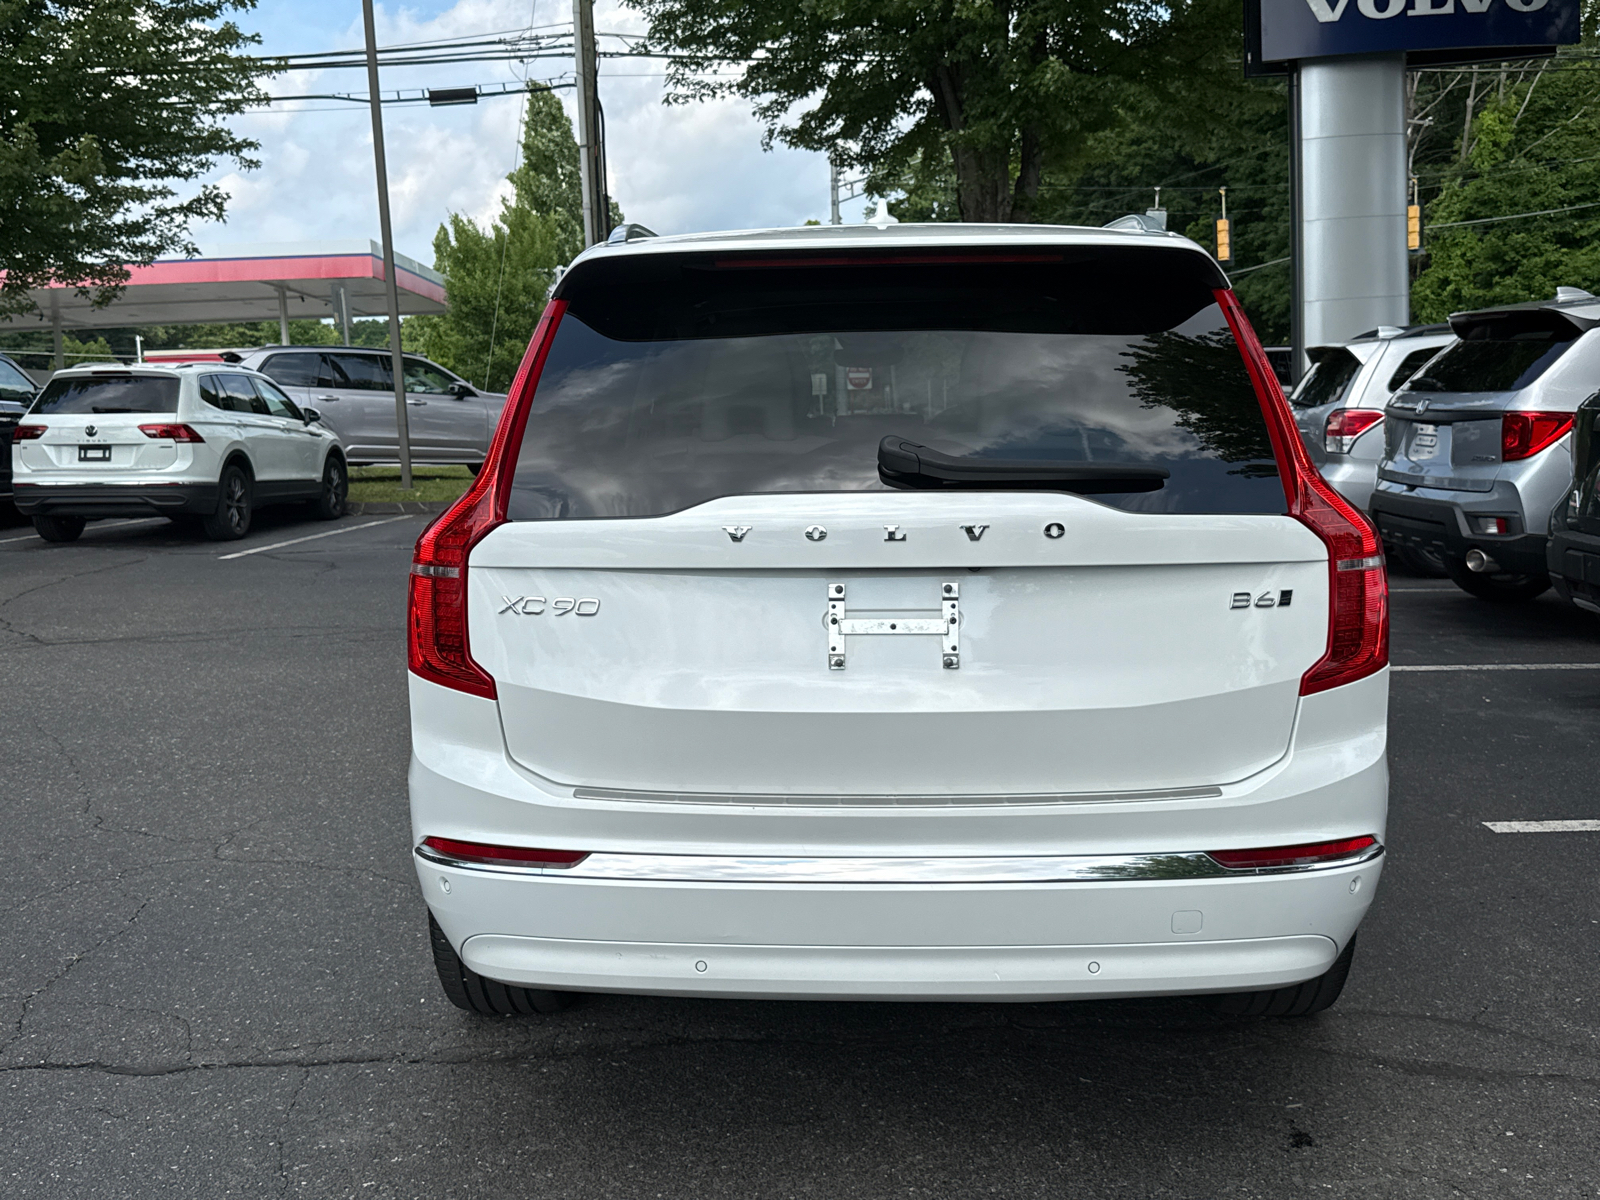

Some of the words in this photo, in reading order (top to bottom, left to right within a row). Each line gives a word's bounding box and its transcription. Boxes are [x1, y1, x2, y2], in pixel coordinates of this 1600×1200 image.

[1306, 0, 1549, 23] VOL
[721, 522, 1066, 542] VOLVO
[1229, 591, 1275, 609] B6
